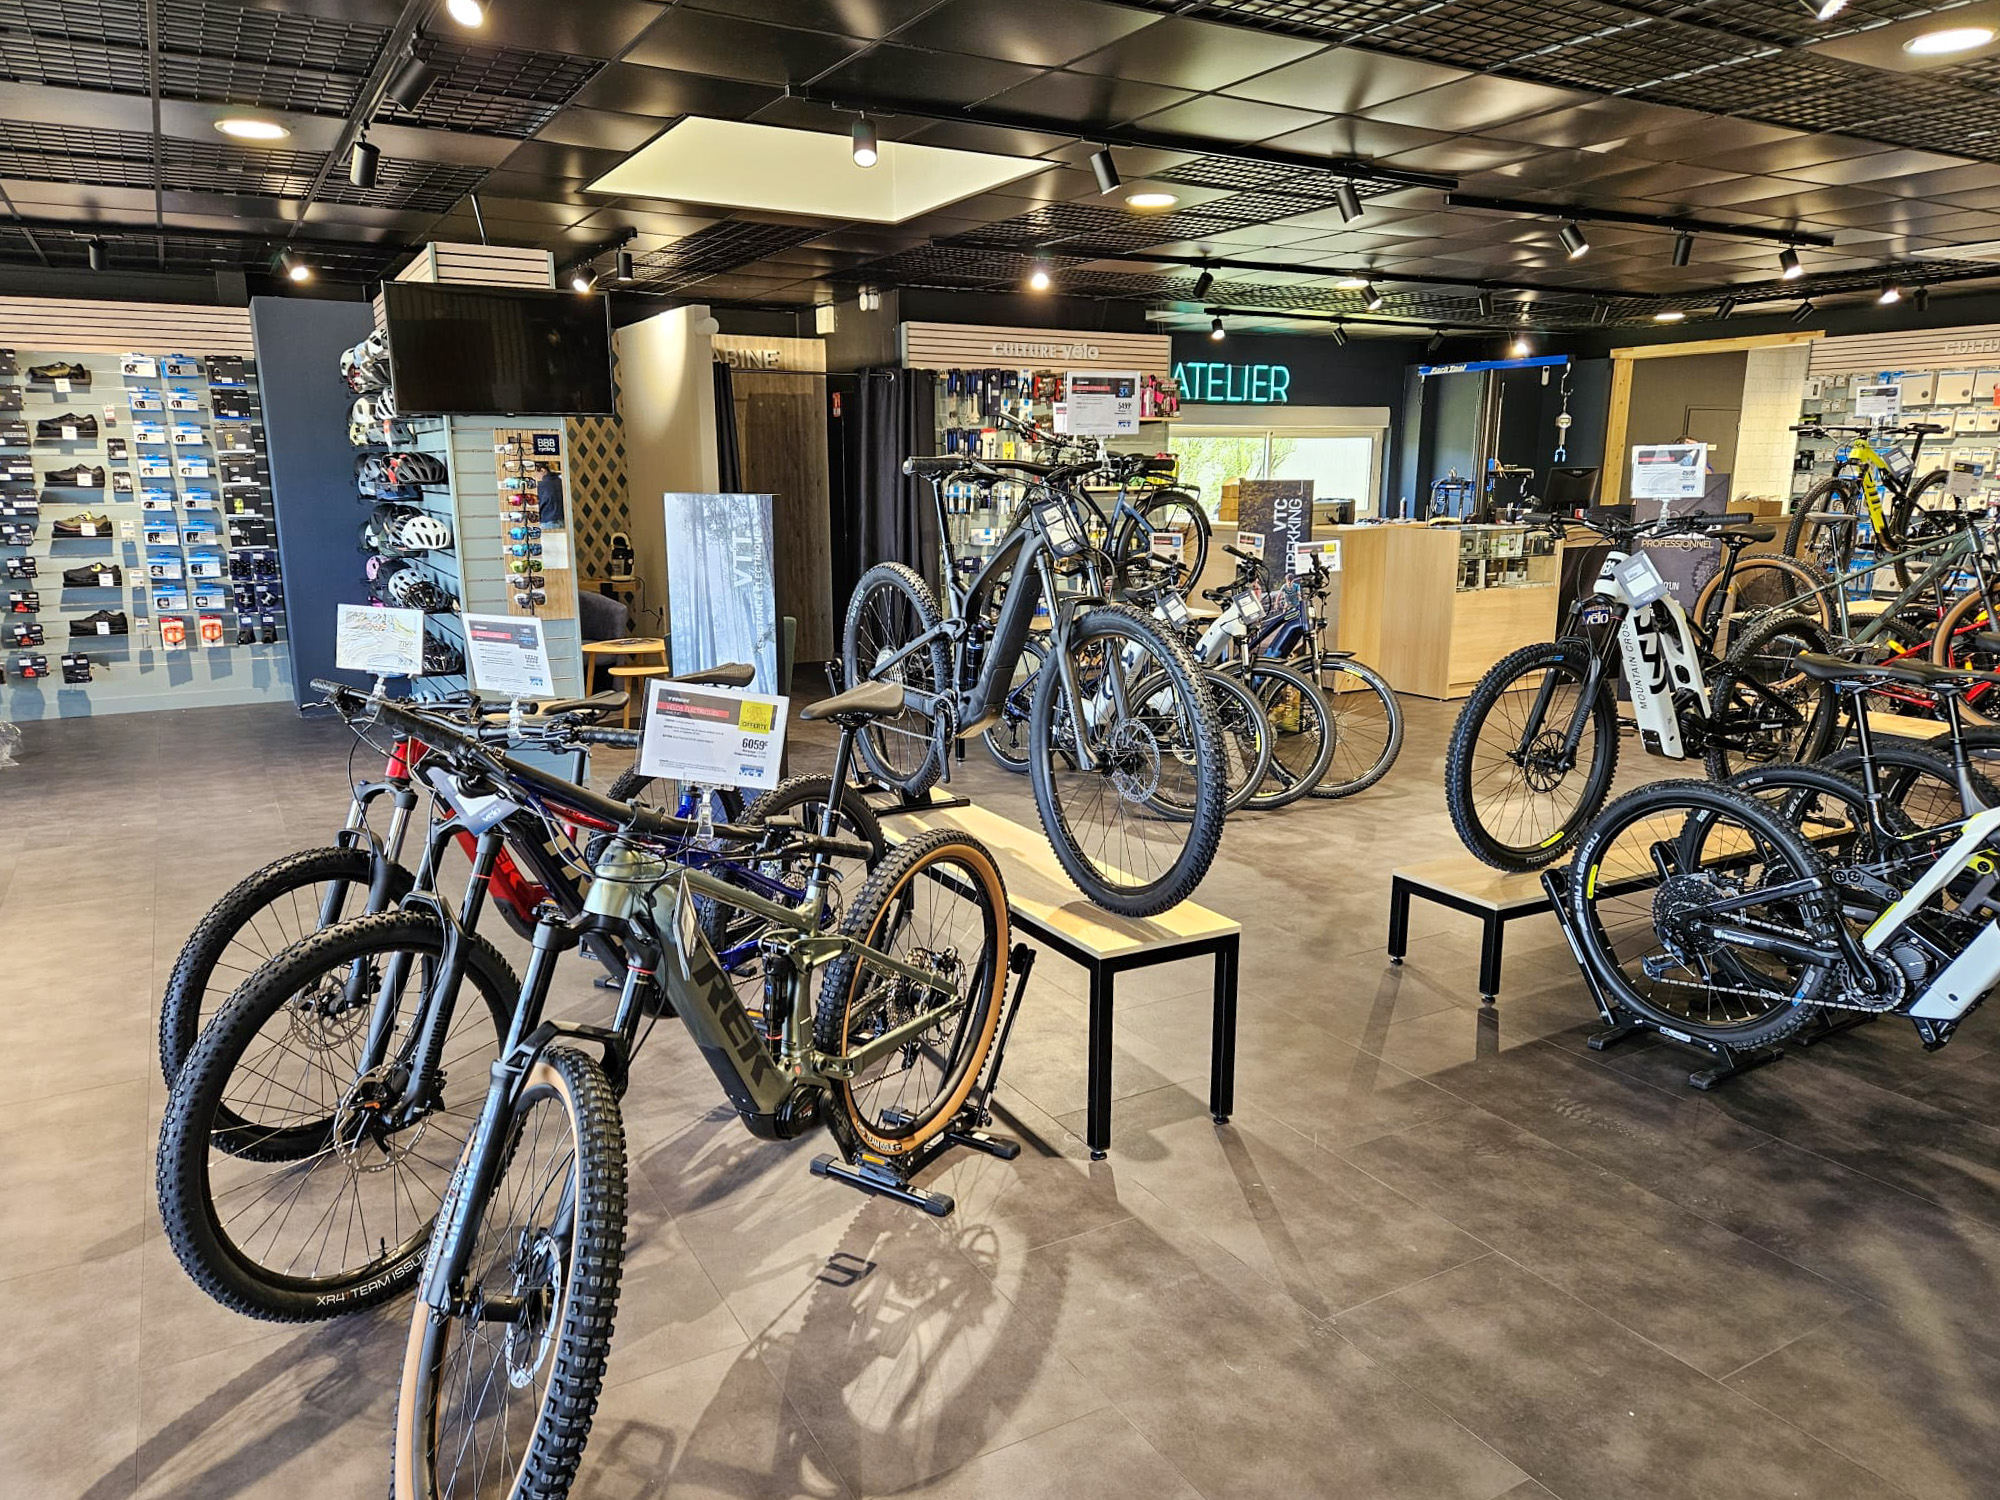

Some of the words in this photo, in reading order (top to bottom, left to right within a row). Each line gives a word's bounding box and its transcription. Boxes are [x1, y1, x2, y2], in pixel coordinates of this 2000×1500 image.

[711, 347, 780, 369] ABINE
[992, 342, 1056, 358] CULTURE
[1173, 362, 1290, 402] ATELIER
[537, 438, 556, 447] BBB
[1273, 498, 1288, 532] VTC
[731, 530, 754, 588] VTT
[1641, 539, 1714, 549] PROFESSIONNEL
[1621, 624, 1634, 652] CROS
[1628, 656, 1648, 709] MOUNTAIN
[741, 720, 768, 731] OFFERTE
[1576, 832, 1601, 884] NOBBY
[436, 1196, 456, 1238] TEAM
[316, 1292, 345, 1307] XR4
[350, 1276, 391, 1299] TEAM
